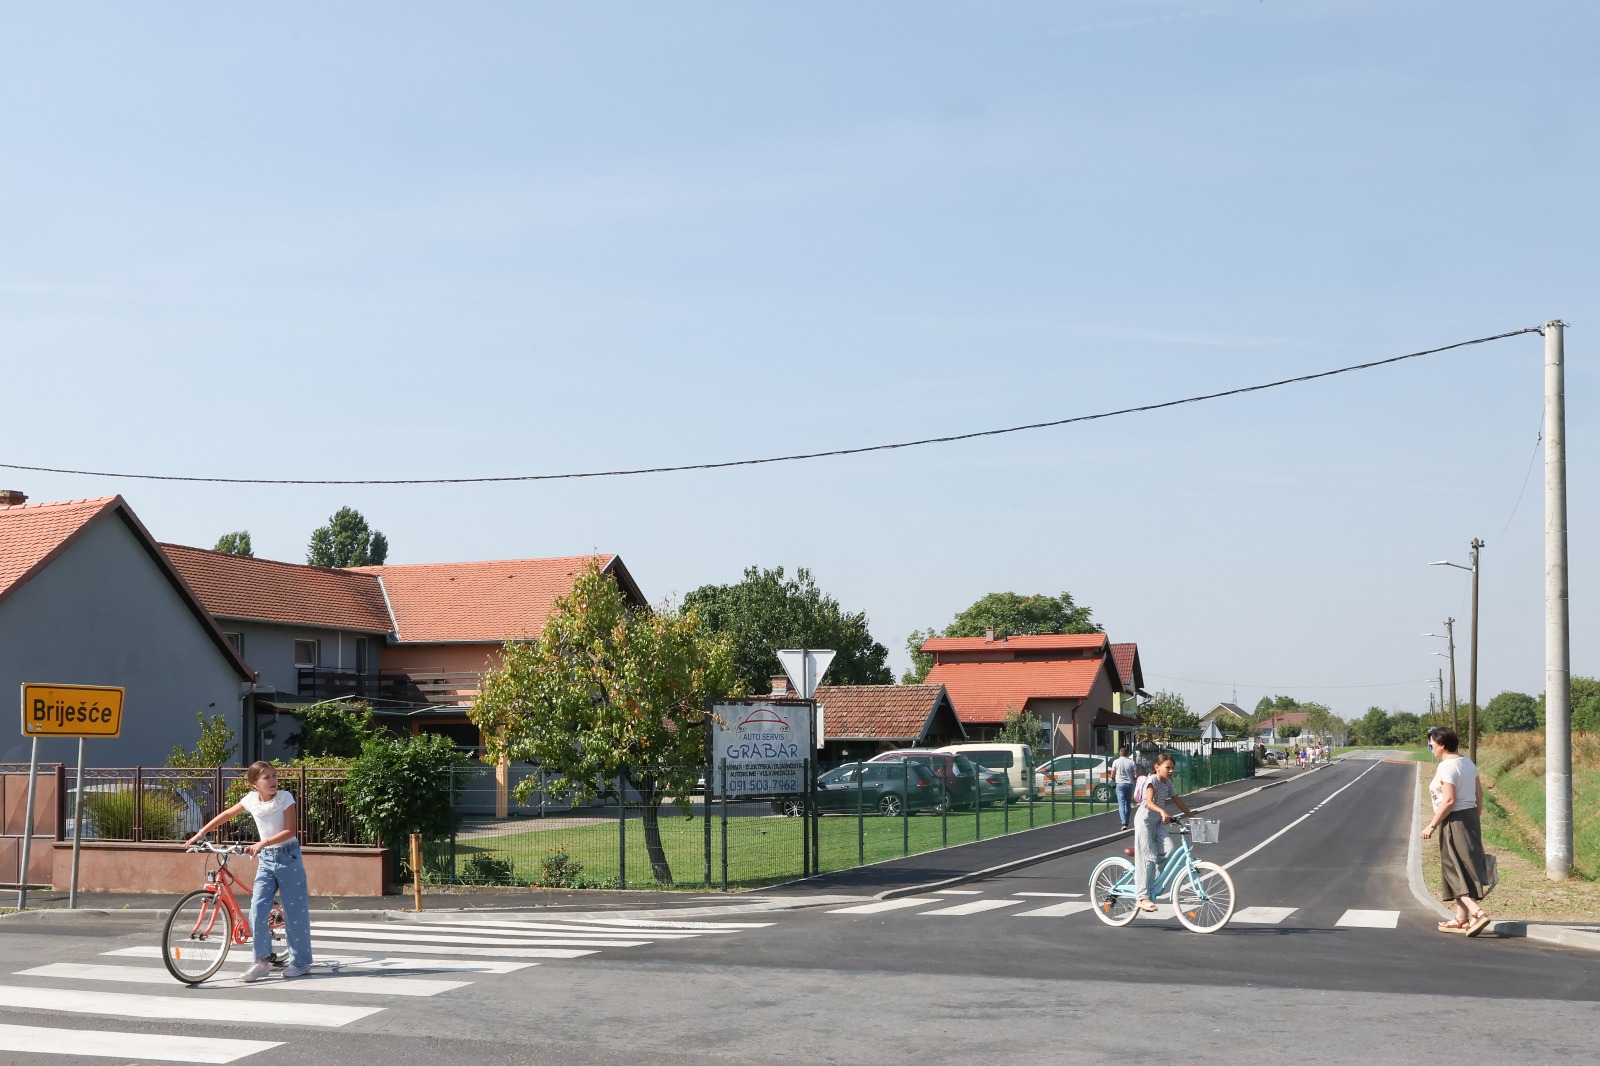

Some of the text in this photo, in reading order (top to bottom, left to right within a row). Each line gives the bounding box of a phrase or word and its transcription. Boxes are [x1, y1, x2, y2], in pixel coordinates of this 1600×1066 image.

[33, 698, 112, 727] Briješće
[762, 733, 785, 741] SERVIS
[727, 743, 798, 759] GRABAR
[729, 779, 796, 792] 091 503 7962
